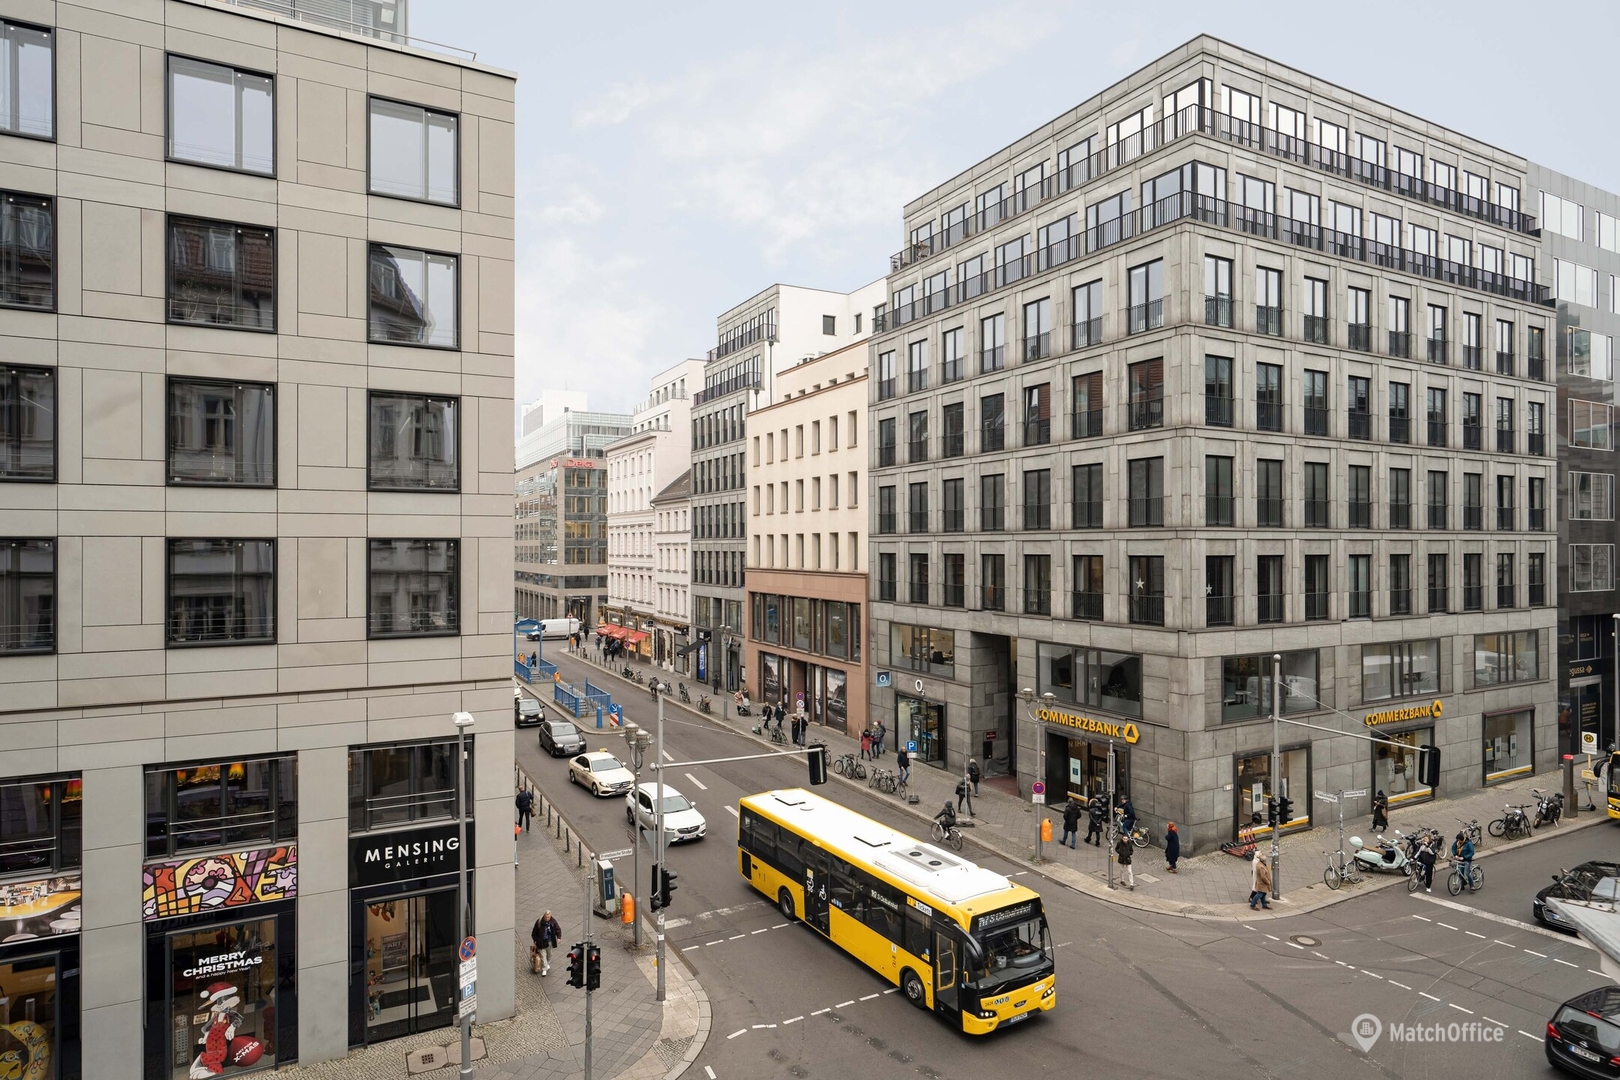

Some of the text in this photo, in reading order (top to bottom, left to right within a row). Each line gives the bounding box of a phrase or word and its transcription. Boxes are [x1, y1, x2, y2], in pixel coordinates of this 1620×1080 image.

[567, 458, 594, 468] Deka
[1035, 709, 1120, 738] COMMERZBANK
[1365, 705, 1431, 726] COMMERZBANK
[365, 837, 460, 863] MENSING
[384, 855, 444, 869] GALERIE
[917, 902, 932, 916] Tickets
[183, 956, 263, 977] CHRISTMAS
[198, 950, 247, 966] MERRY
[465, 984, 472, 996] P
[233, 1041, 260, 1063] X-MAS
